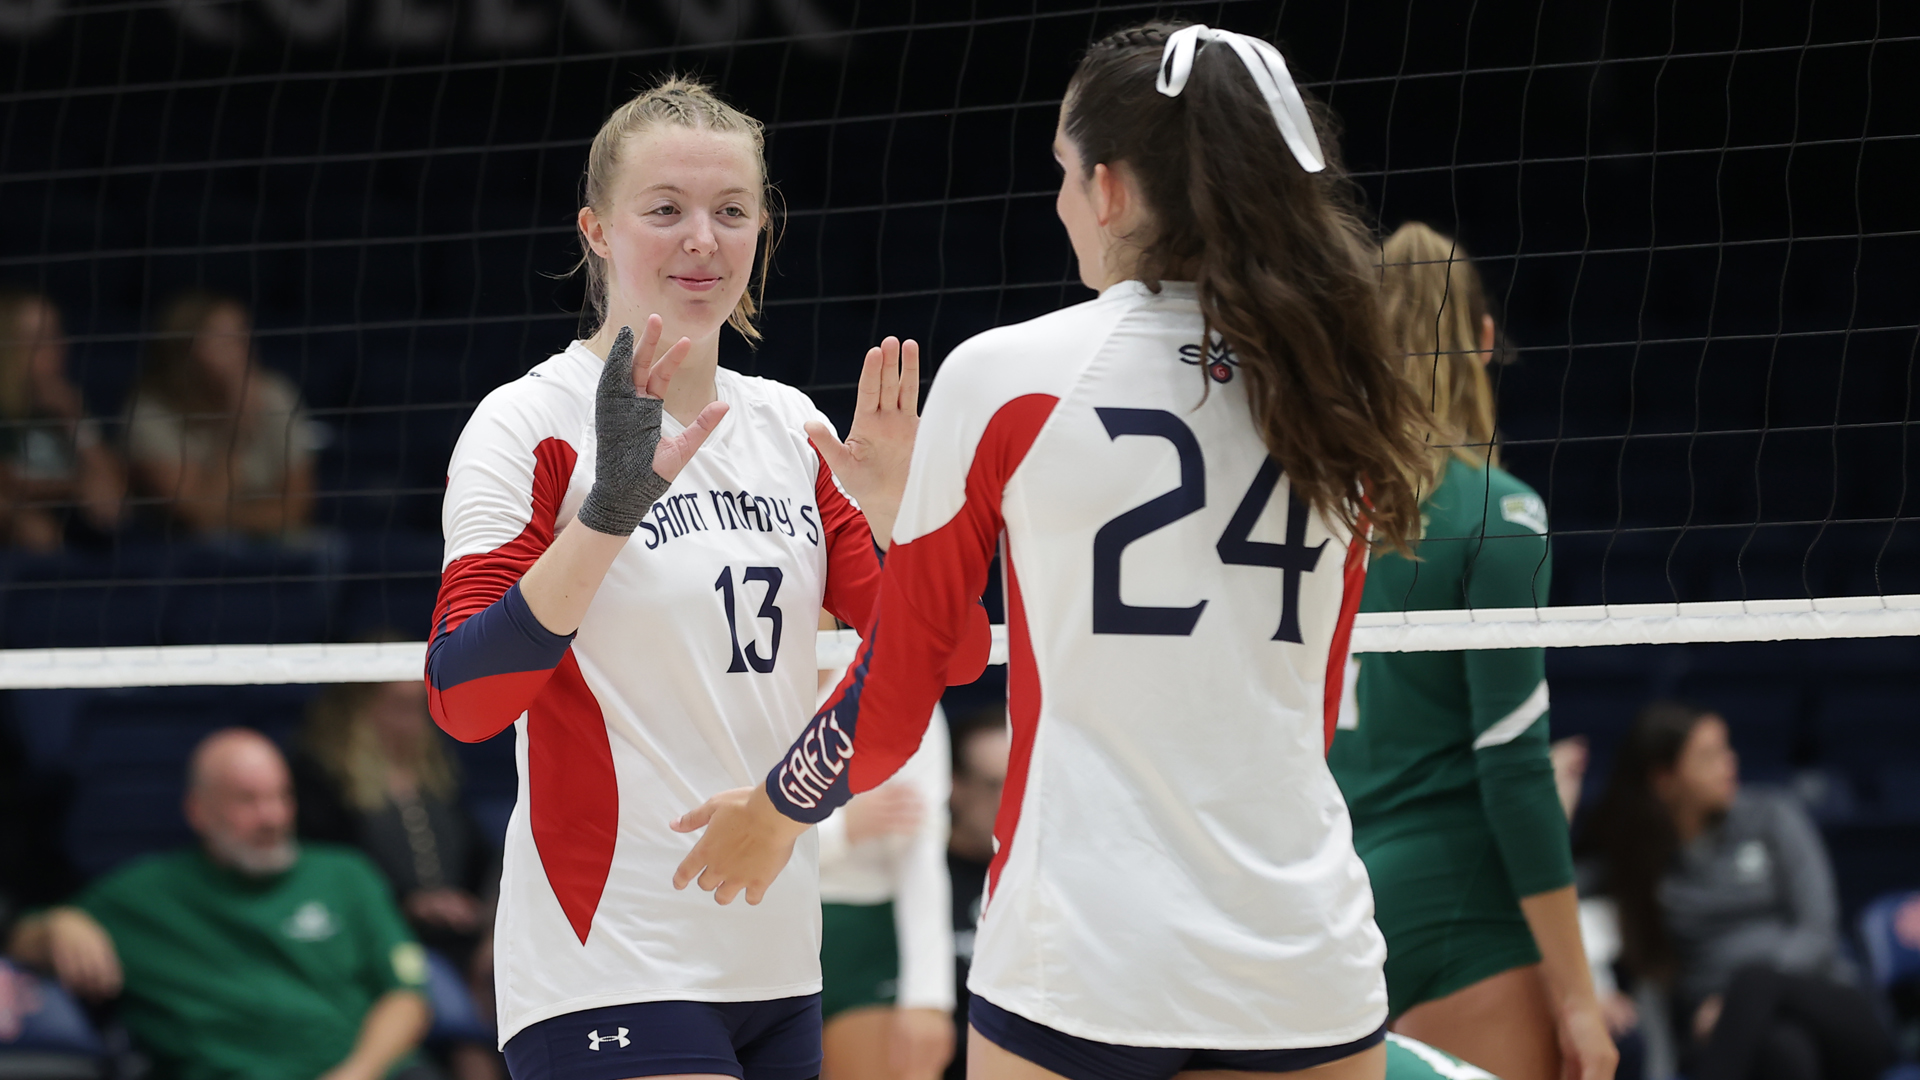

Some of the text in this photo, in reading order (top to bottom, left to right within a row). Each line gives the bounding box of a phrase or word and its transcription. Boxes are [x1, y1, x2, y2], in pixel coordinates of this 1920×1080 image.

[638, 492, 709, 550] SAINT
[1093, 407, 1331, 645] 24
[714, 565, 784, 674] 13
[778, 708, 856, 809] GAELS
